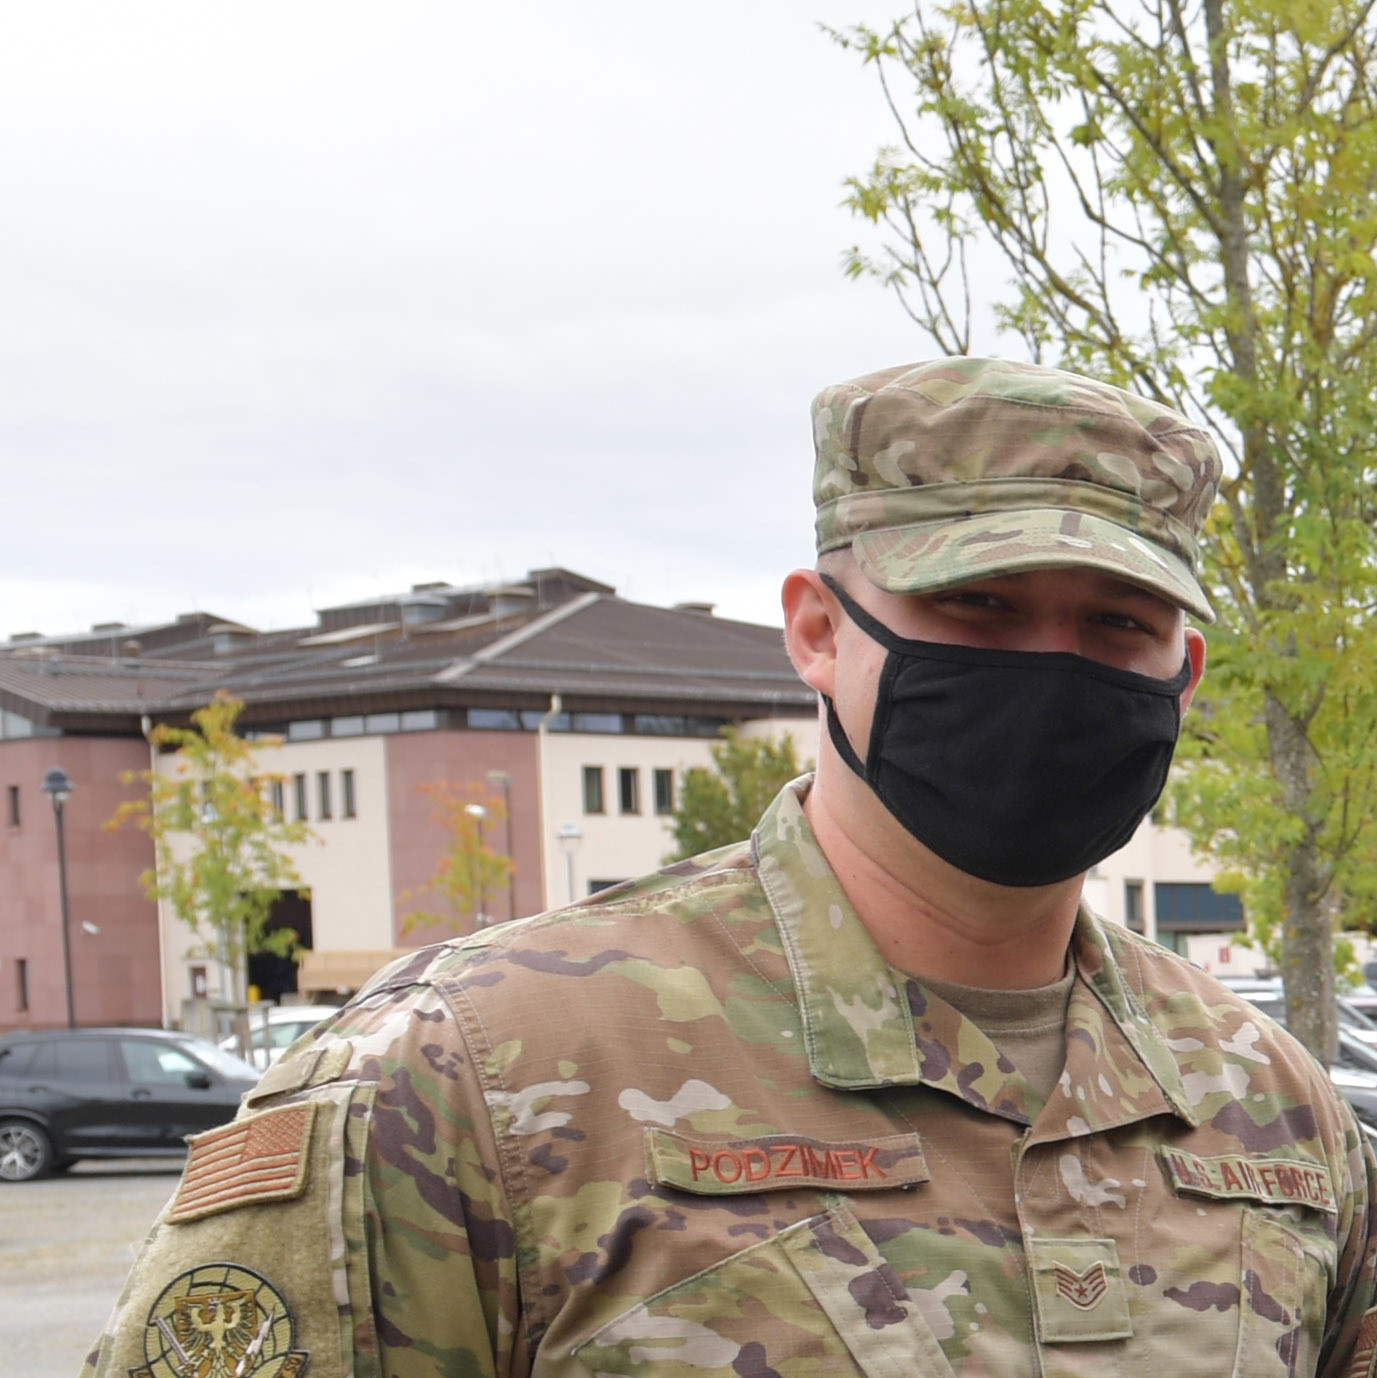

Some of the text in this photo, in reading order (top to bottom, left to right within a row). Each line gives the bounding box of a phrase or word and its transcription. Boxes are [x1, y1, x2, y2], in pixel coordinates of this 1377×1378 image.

[689, 1145, 888, 1184] PODZIMEK
[1219, 1160, 1263, 1196] AIR
[1258, 1163, 1331, 1205] FORCE
